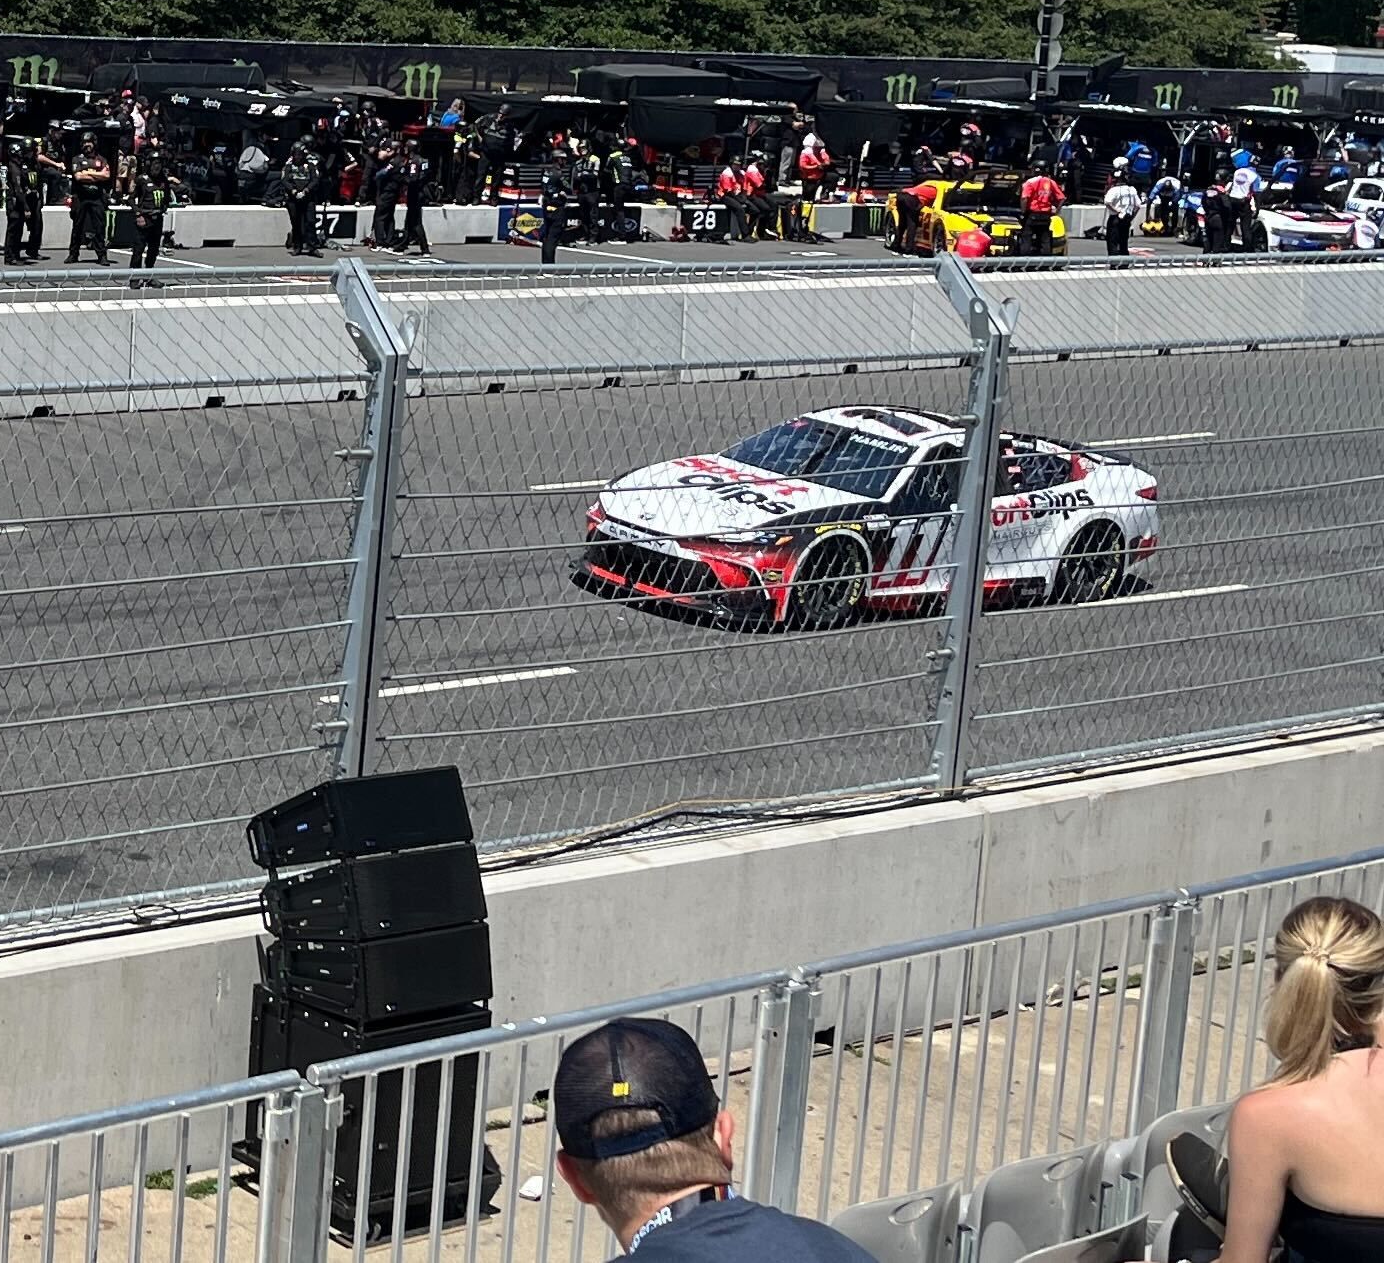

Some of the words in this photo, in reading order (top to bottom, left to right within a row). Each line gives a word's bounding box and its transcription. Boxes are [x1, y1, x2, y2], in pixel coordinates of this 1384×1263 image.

[271, 104, 291, 116] 45
[692, 210, 716, 230] 28
[849, 434, 908, 453] HAMLIN
